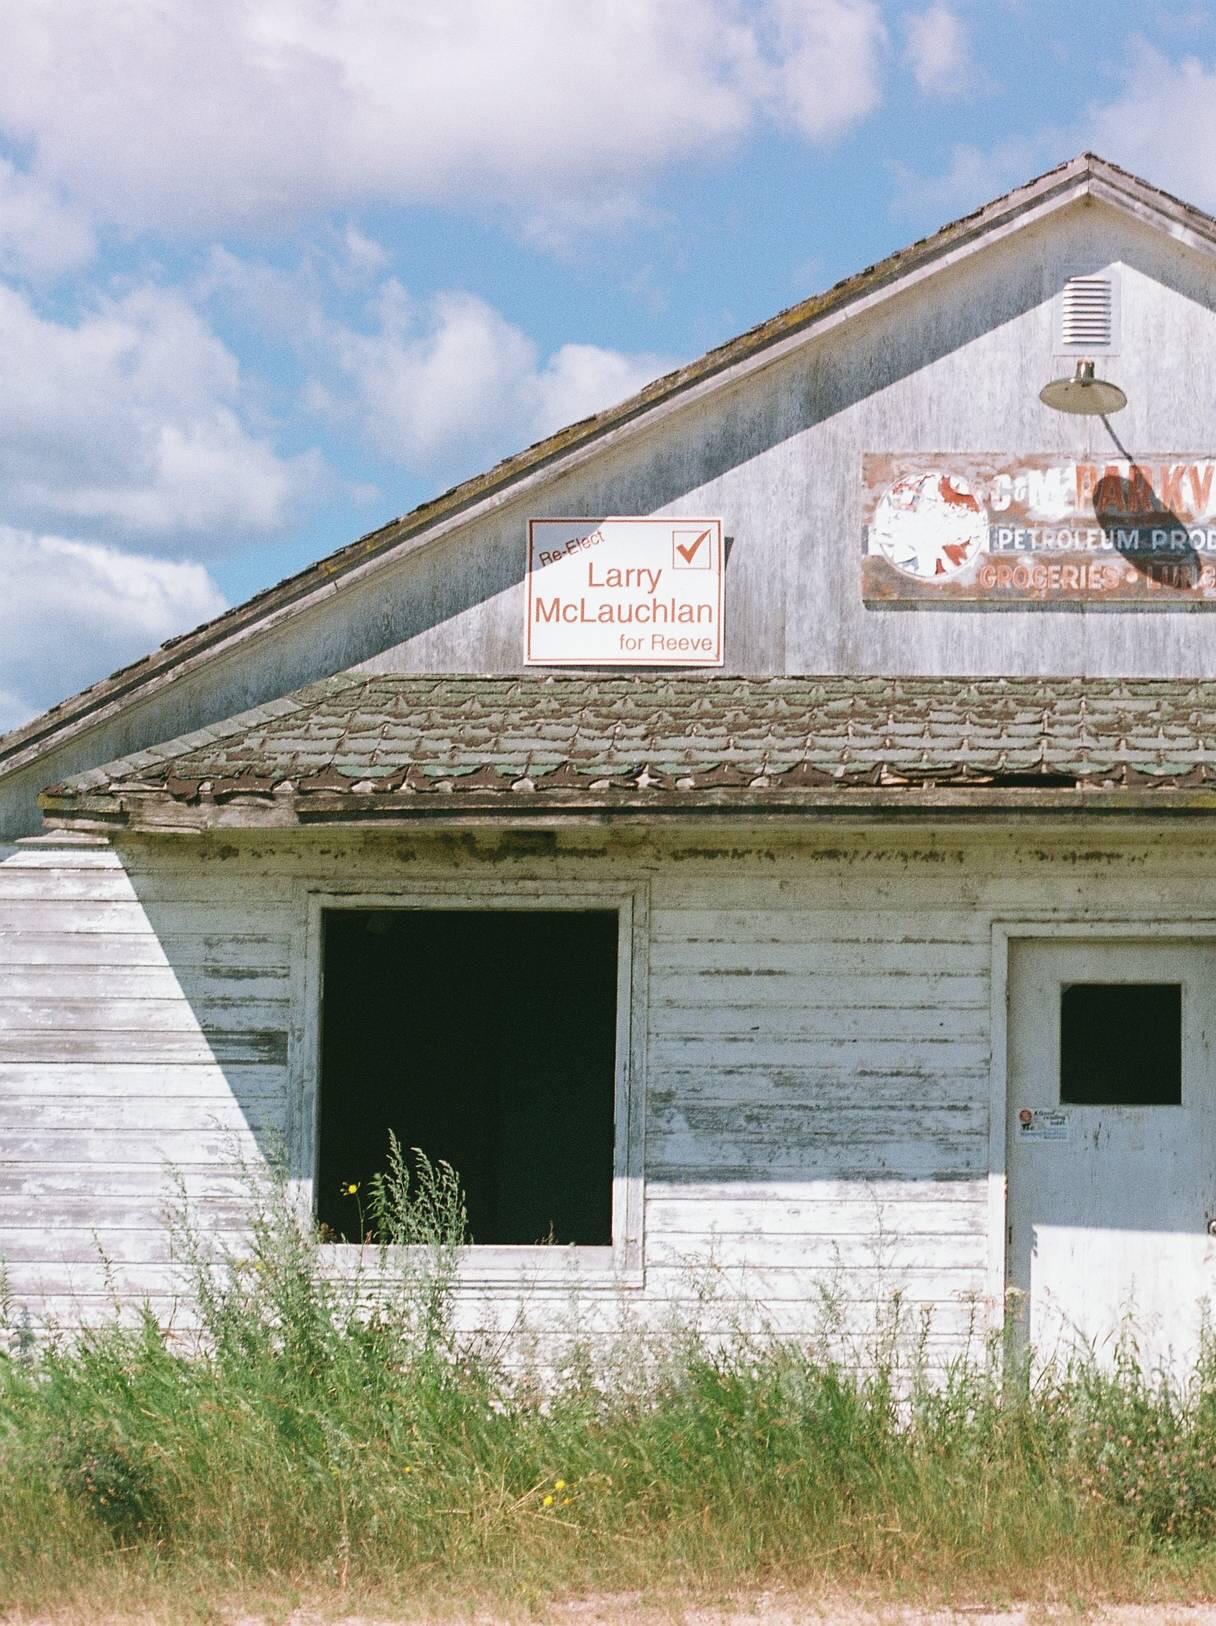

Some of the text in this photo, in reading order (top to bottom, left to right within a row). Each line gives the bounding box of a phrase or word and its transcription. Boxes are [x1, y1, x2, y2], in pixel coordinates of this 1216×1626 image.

[538, 530, 605, 567] Re-Elect
[998, 528, 1139, 550] PETROLEUM
[588, 562, 663, 594] Larry
[979, 564, 1120, 590] GROCERIES
[535, 597, 713, 624] McLauchlan
[619, 633, 713, 651] for Reeve
